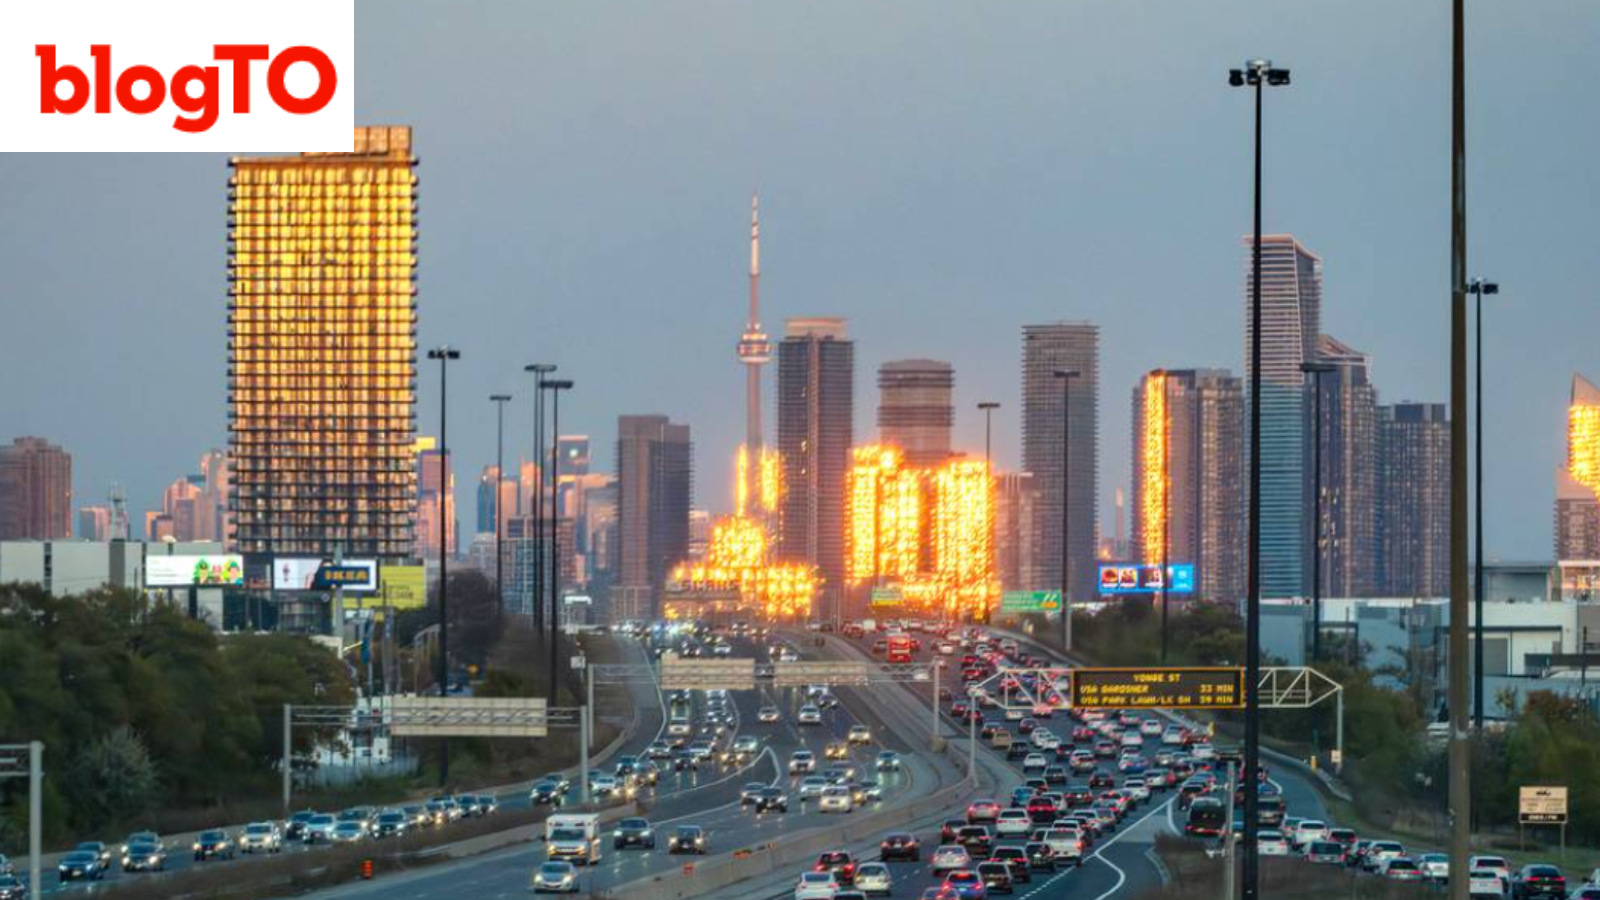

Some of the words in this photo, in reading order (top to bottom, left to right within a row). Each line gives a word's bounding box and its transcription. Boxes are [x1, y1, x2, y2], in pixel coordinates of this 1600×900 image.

[325, 571, 368, 580] IKEA
[1133, 673, 1164, 683] YONGE
[1168, 673, 1181, 683] ST
[1080, 684, 1098, 694] VIA
[1101, 684, 1149, 694] GARDINER
[1216, 684, 1234, 694] MIN
[1080, 695, 1098, 705] VIA
[1102, 695, 1127, 705] PARK
[1216, 695, 1234, 705] MIN
